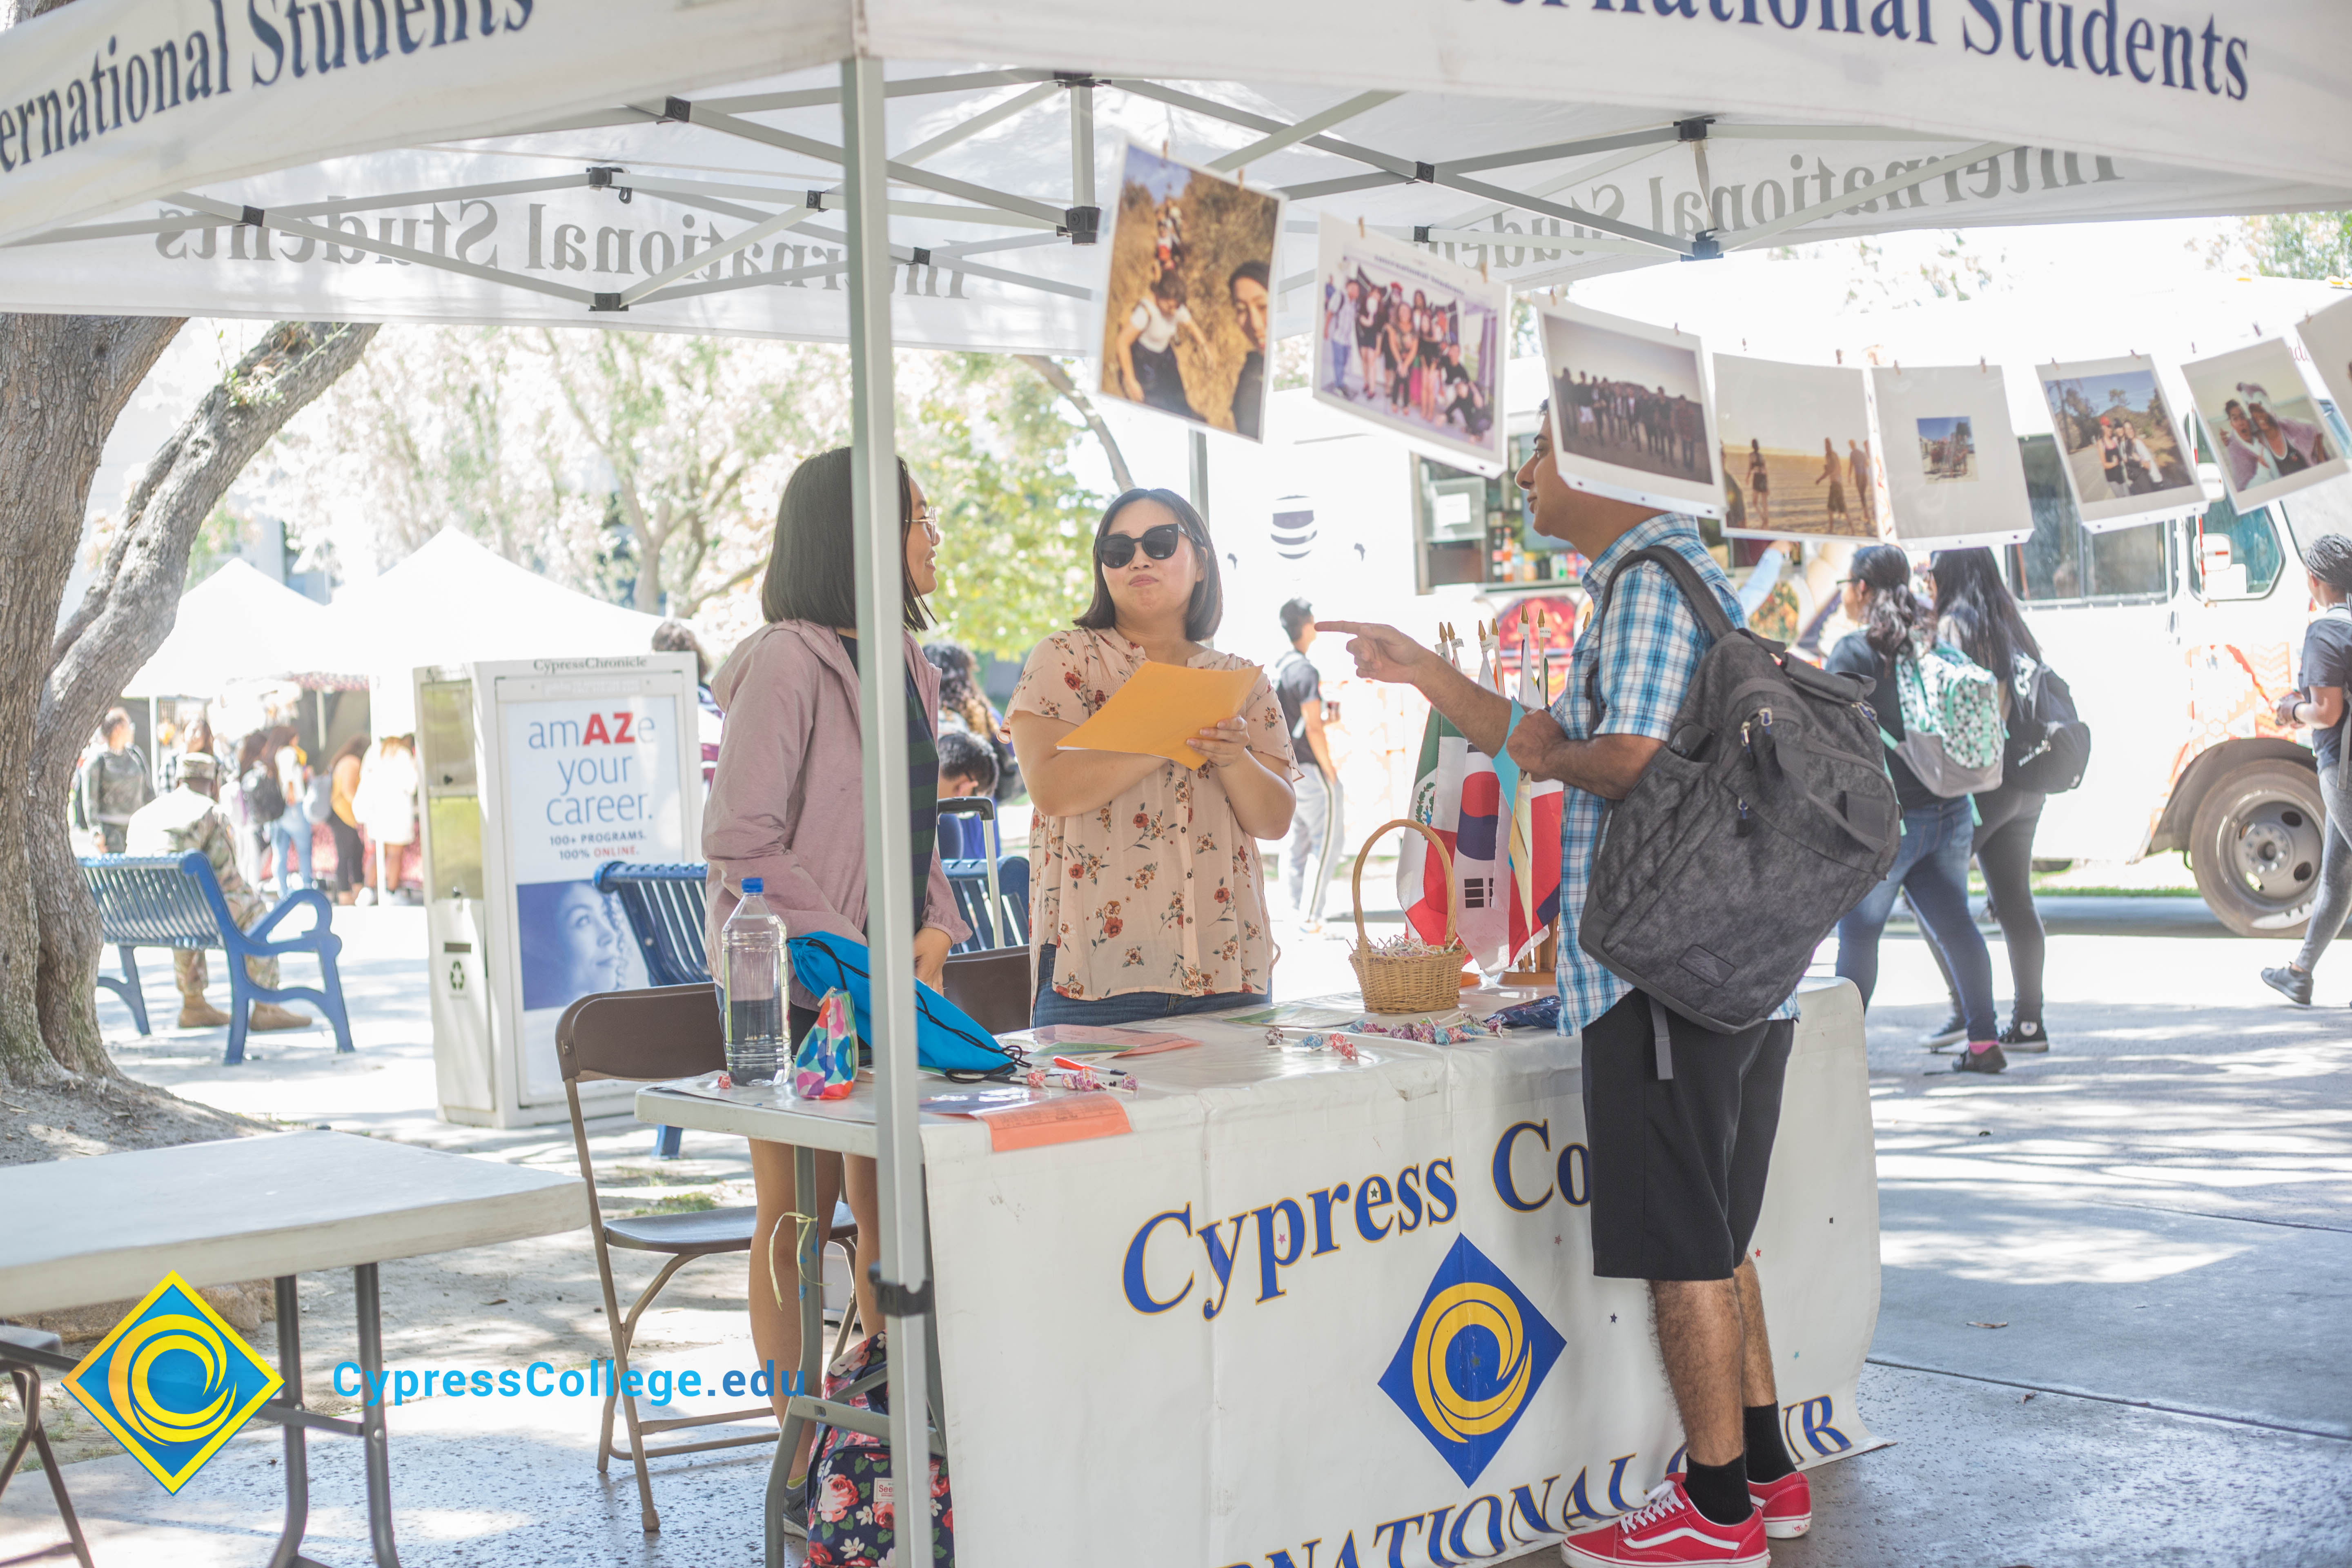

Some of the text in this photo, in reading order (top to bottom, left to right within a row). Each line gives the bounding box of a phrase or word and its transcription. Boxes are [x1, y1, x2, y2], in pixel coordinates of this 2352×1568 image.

[1962, 0, 2249, 101] Students
[0, 0, 231, 172] ernational
[533, 656, 647, 674] CypressChronicle
[528, 711, 655, 750] amAZe
[557, 755, 633, 796] your
[546, 793, 653, 826] career.
[550, 830, 647, 846] 100+ PROGRAMS.
[559, 846, 639, 860] 100% ONLINE.
[1121, 1118, 1591, 1321] Cypress Co
[1222, 1452, 1656, 1568] ATIONAL
